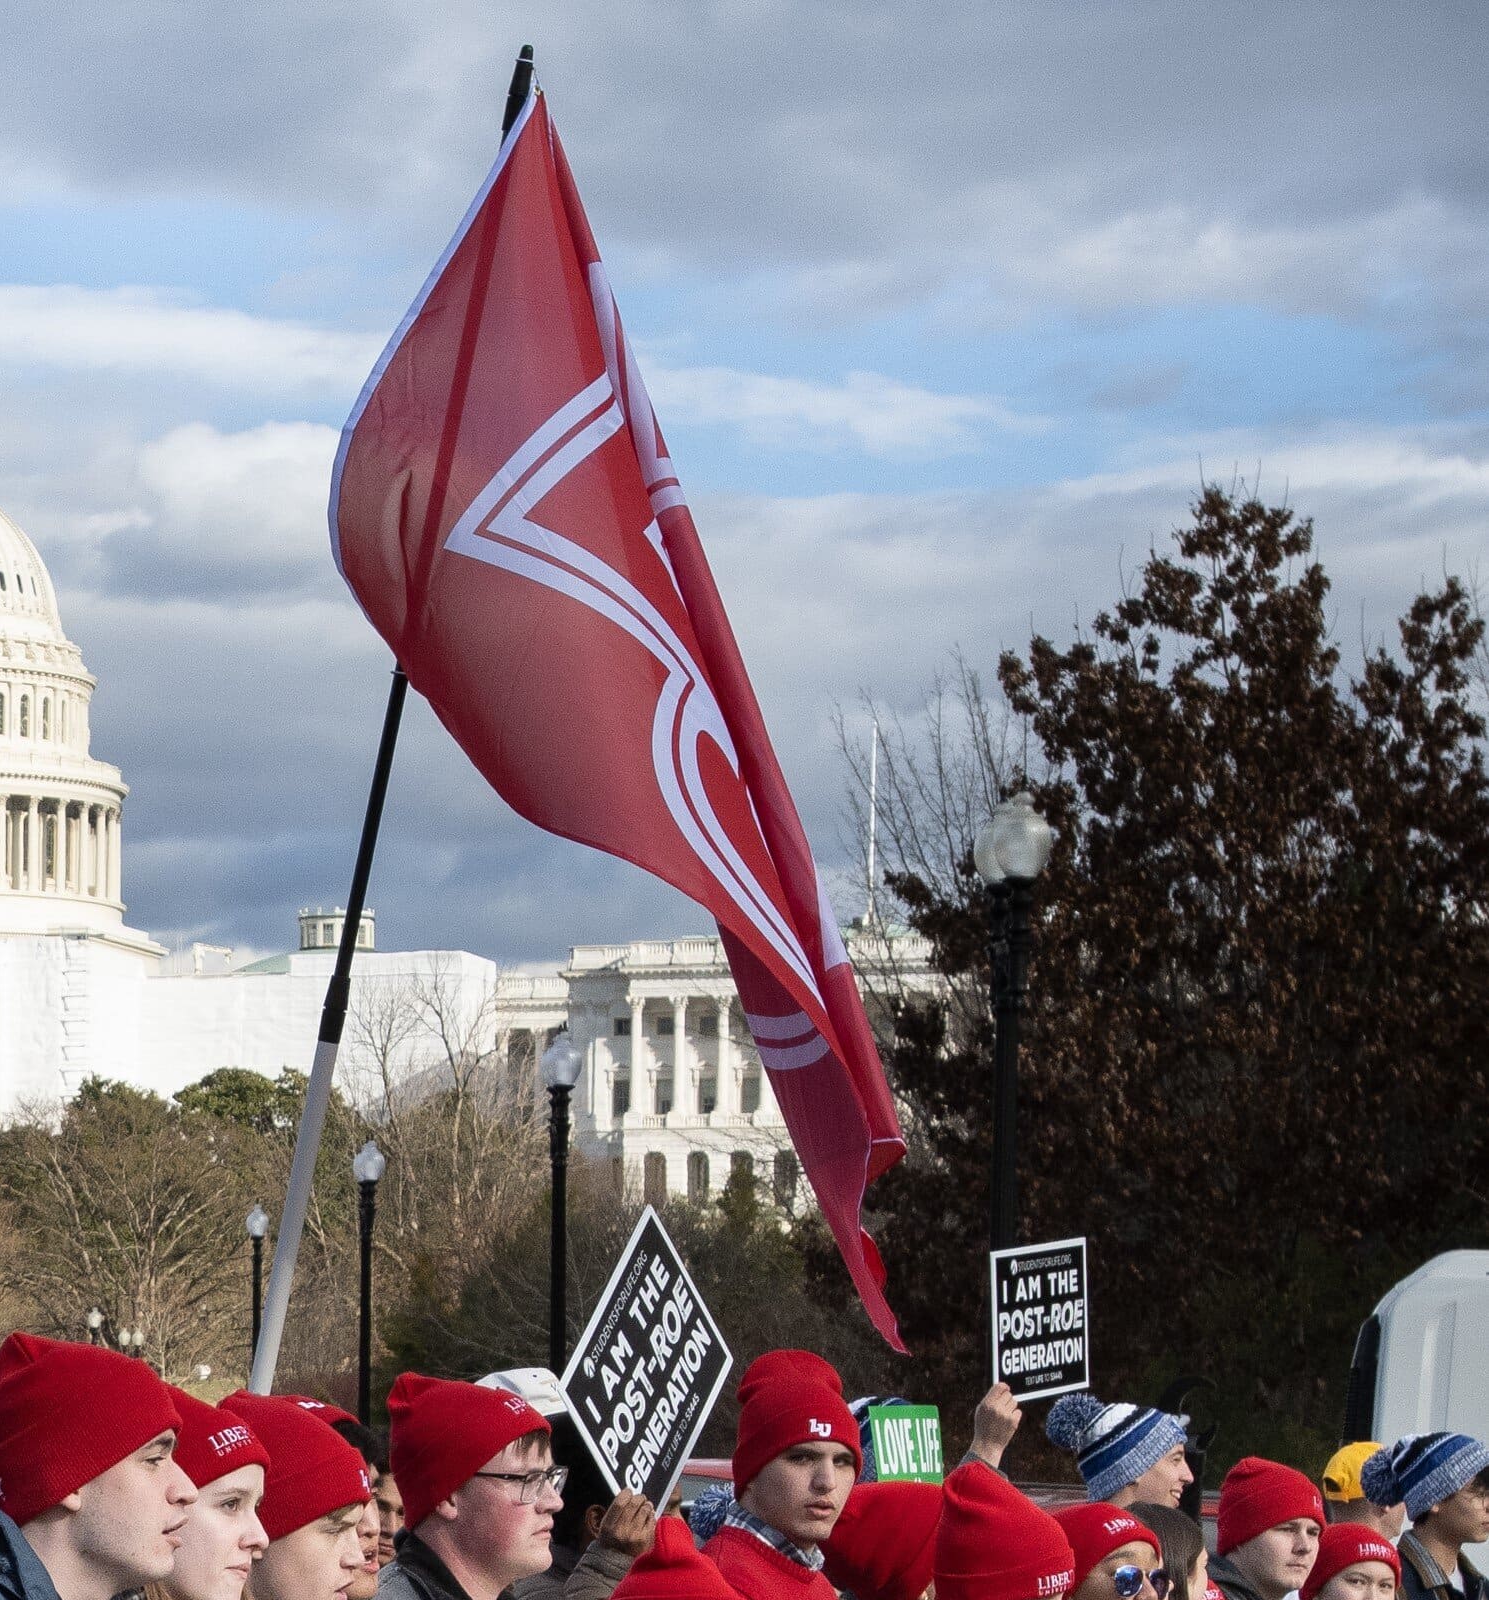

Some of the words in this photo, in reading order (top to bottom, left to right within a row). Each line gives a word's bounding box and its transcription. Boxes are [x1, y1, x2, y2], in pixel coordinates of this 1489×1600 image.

[1003, 1280, 1008, 1304] I
[1015, 1275, 1041, 1302] AM
[1048, 1269, 1078, 1296] THE
[586, 1396, 602, 1425] I
[599, 1330, 634, 1401] AM
[629, 1254, 670, 1329] THE
[999, 1299, 1083, 1342] POST-ROE
[600, 1275, 693, 1471] POST-ROE
[1001, 1337, 1083, 1376] GENERATION
[625, 1318, 712, 1496] GENERATION
[809, 1418, 832, 1437] LU
[875, 1418, 917, 1474] LOVE
[915, 1418, 941, 1473] LIFE
